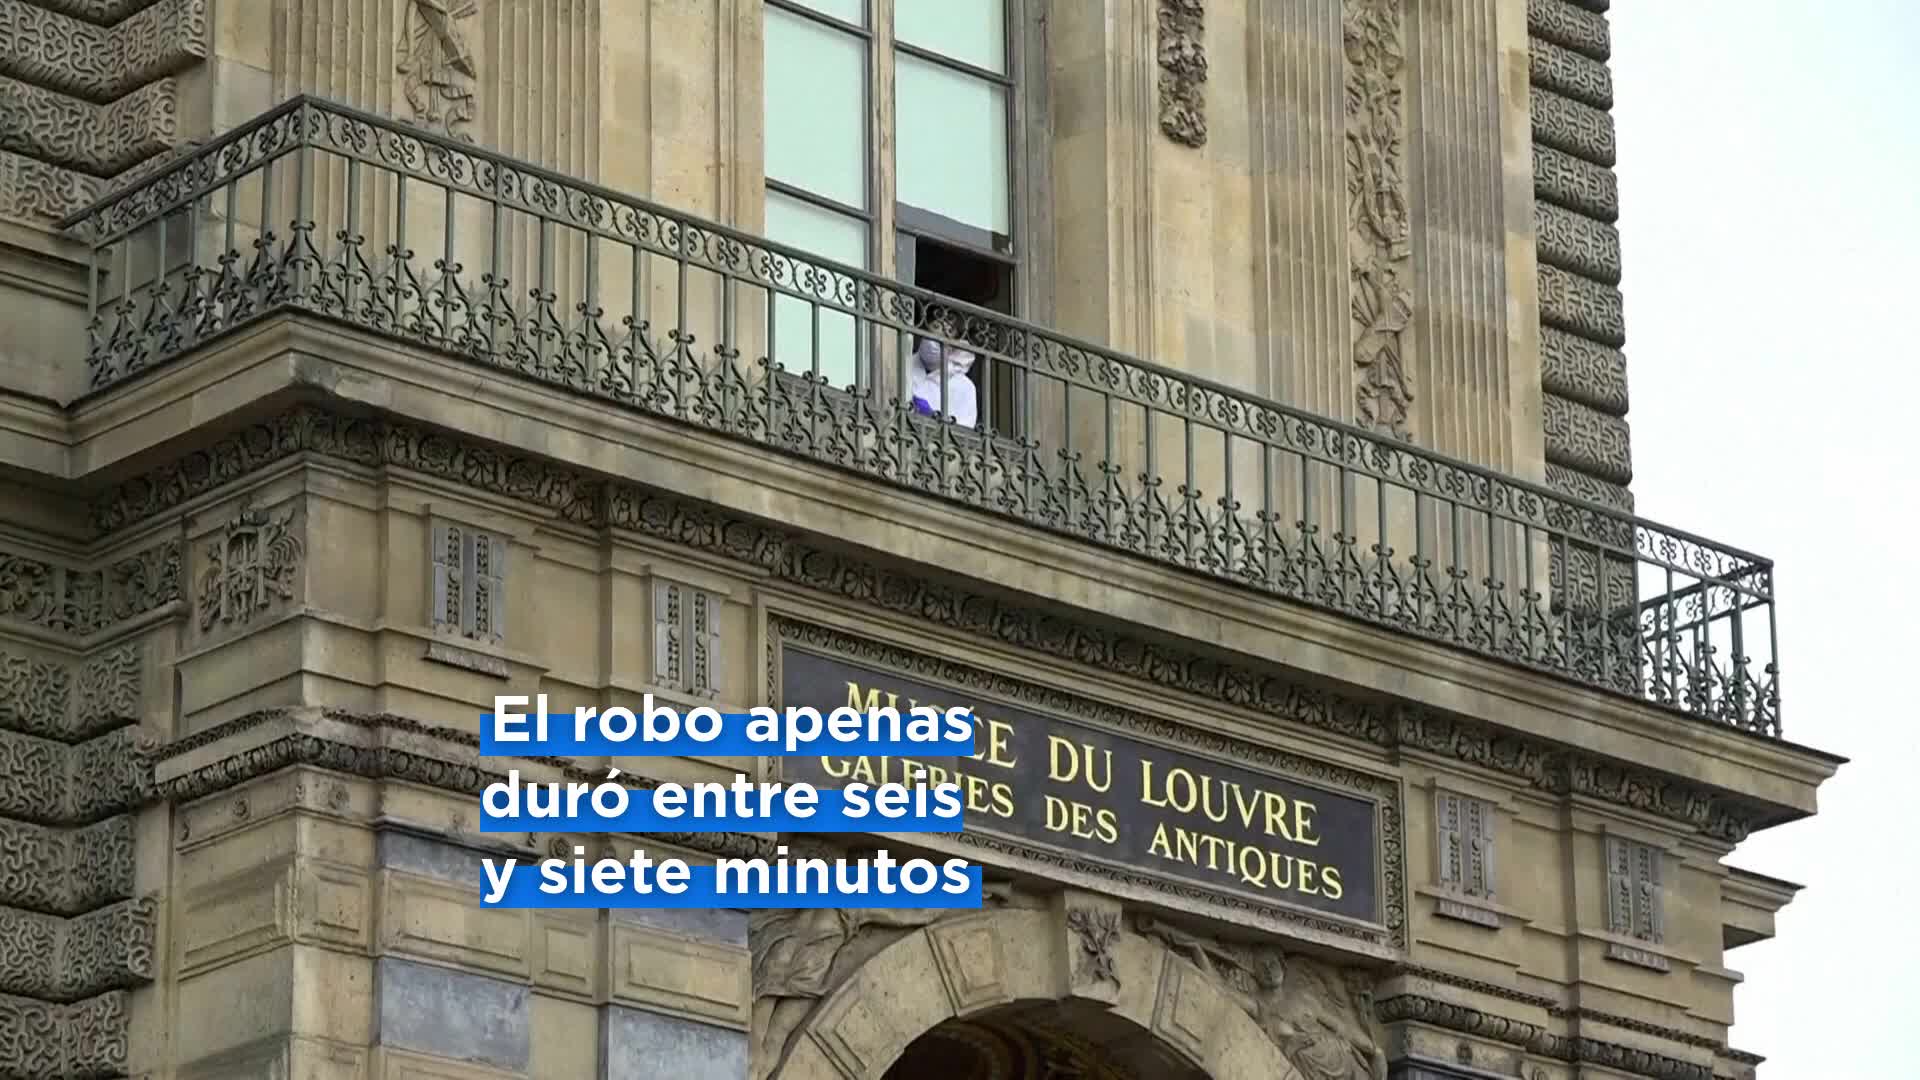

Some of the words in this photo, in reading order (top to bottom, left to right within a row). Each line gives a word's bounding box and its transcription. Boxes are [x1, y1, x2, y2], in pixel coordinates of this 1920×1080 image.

[1048, 735, 1112, 792] DU
[1140, 759, 1320, 846] LOUVRE
[1044, 795, 1118, 843] DES
[1148, 822, 1344, 900] ANTIQUES
